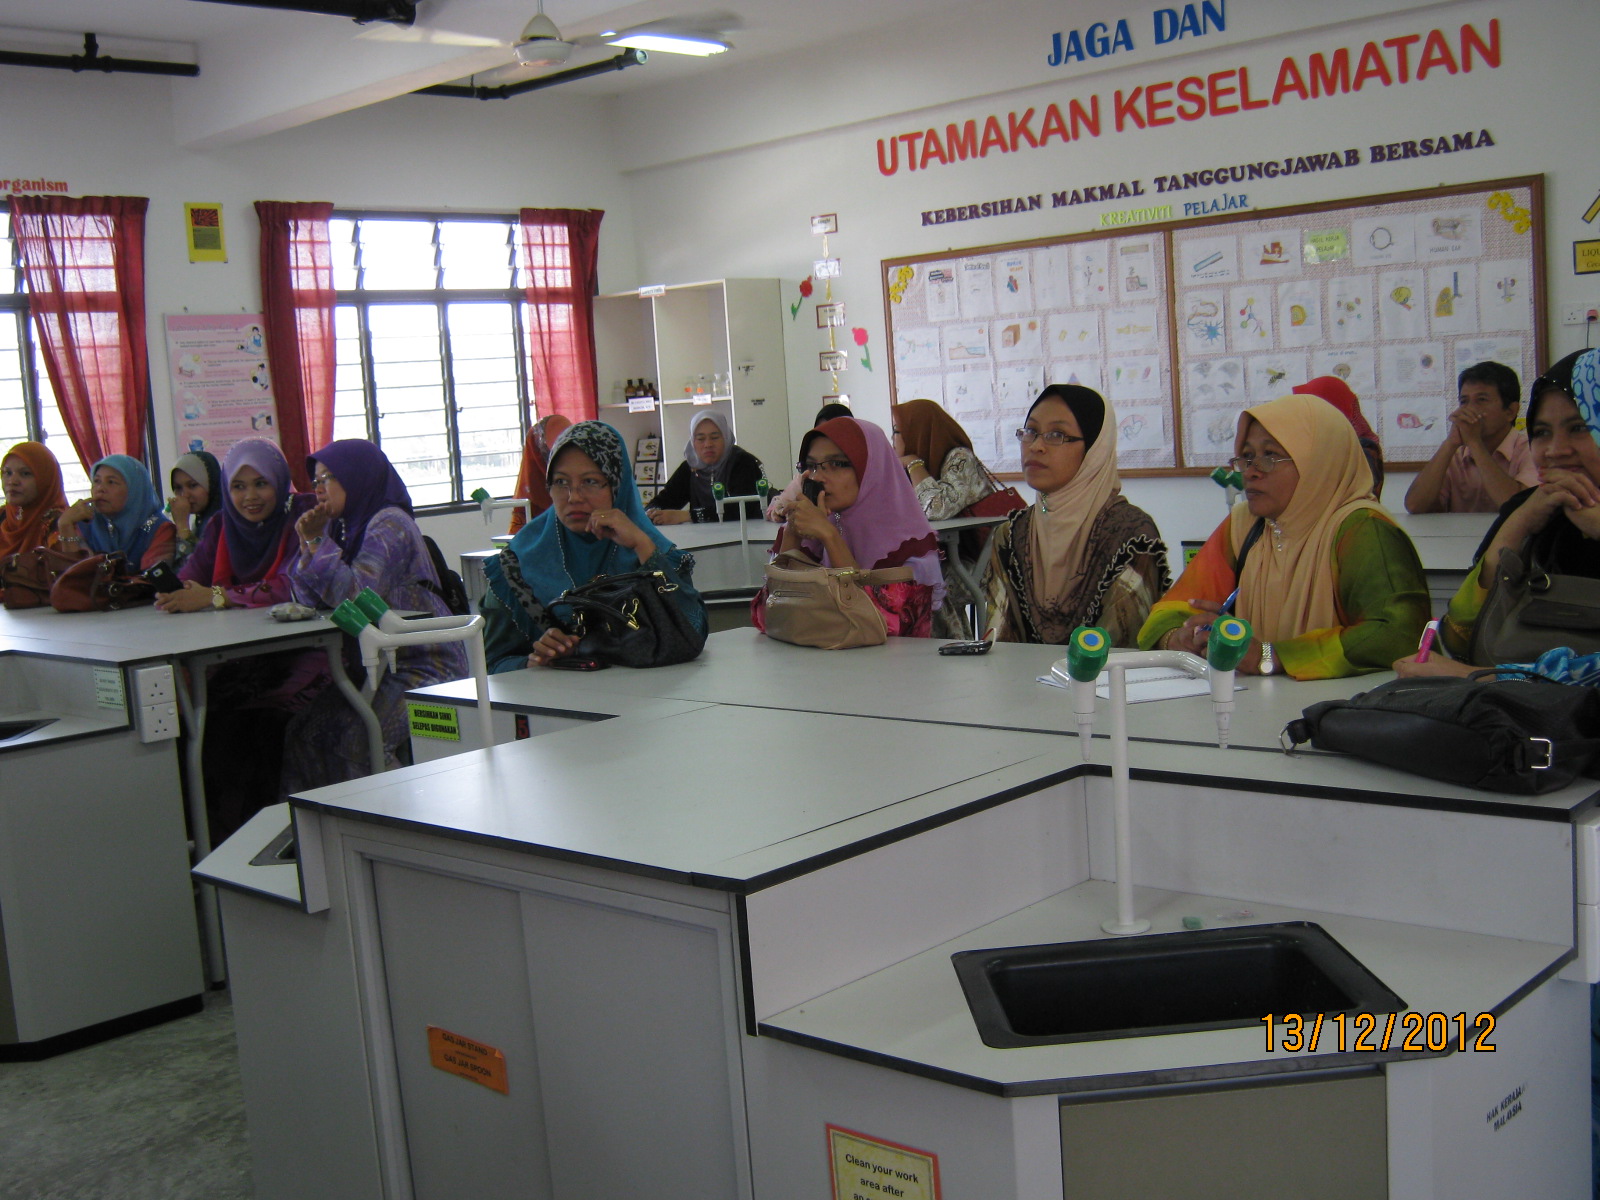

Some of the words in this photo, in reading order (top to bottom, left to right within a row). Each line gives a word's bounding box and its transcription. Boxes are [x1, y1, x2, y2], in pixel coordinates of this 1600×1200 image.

[1047, 18, 1134, 67] JAGA
[1153, 0, 1225, 45] DAN
[877, 94, 1101, 177] UTAMAKAN
[1114, 18, 1501, 133] KESELAMATAN
[921, 194, 1042, 227] KEBERSIHAN
[1052, 180, 1145, 208] MAKMAL
[1154, 149, 1361, 193] TANGGUNGJAWAB
[1370, 128, 1496, 164] BERSAMA
[1100, 205, 1172, 226] KREATIVITI
[1183, 193, 1249, 216] PELAJAR
[1486, 1105, 1499, 1124] HAK
[845, 1153, 871, 1170] Clean
[872, 1163, 893, 1177] your
[895, 1170, 919, 1184] work
[860, 1178, 880, 1191] area
[882, 1185, 905, 1198] after
